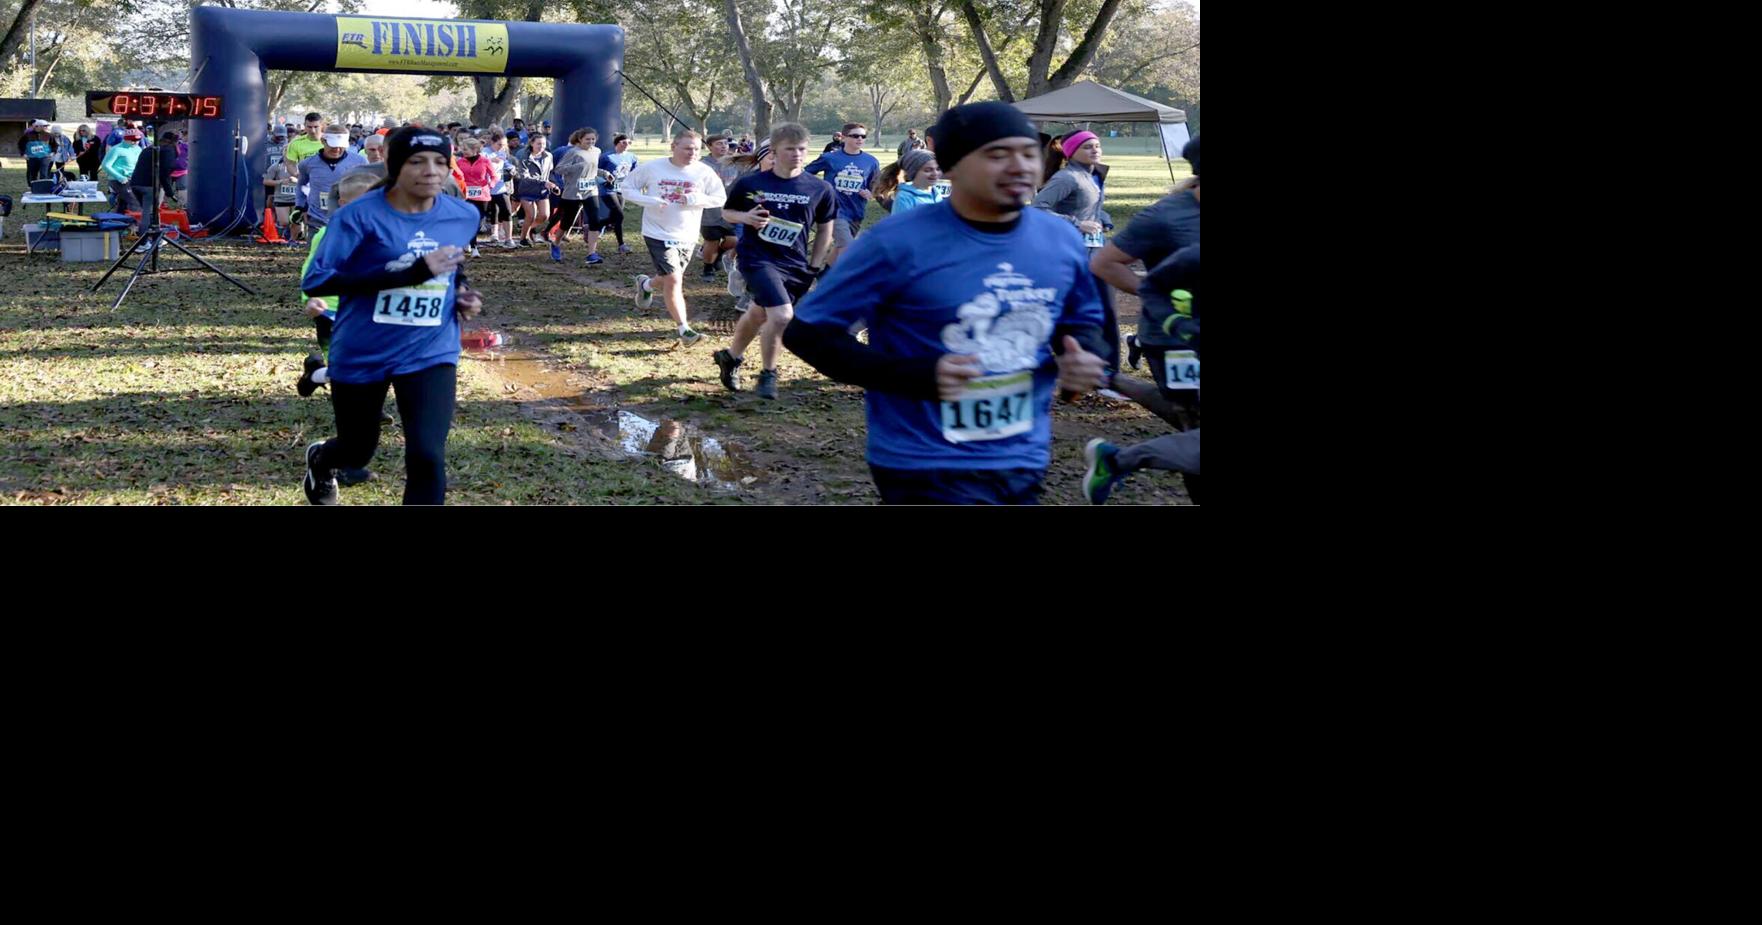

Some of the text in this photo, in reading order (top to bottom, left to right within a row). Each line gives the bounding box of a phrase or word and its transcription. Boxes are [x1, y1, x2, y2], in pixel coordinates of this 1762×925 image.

[371, 21, 478, 58] FINISH
[837, 180, 862, 190] 1337
[761, 225, 797, 242] 1604
[379, 294, 442, 318] 1458
[1170, 364, 1200, 383] 14
[950, 392, 1029, 429] 1647
